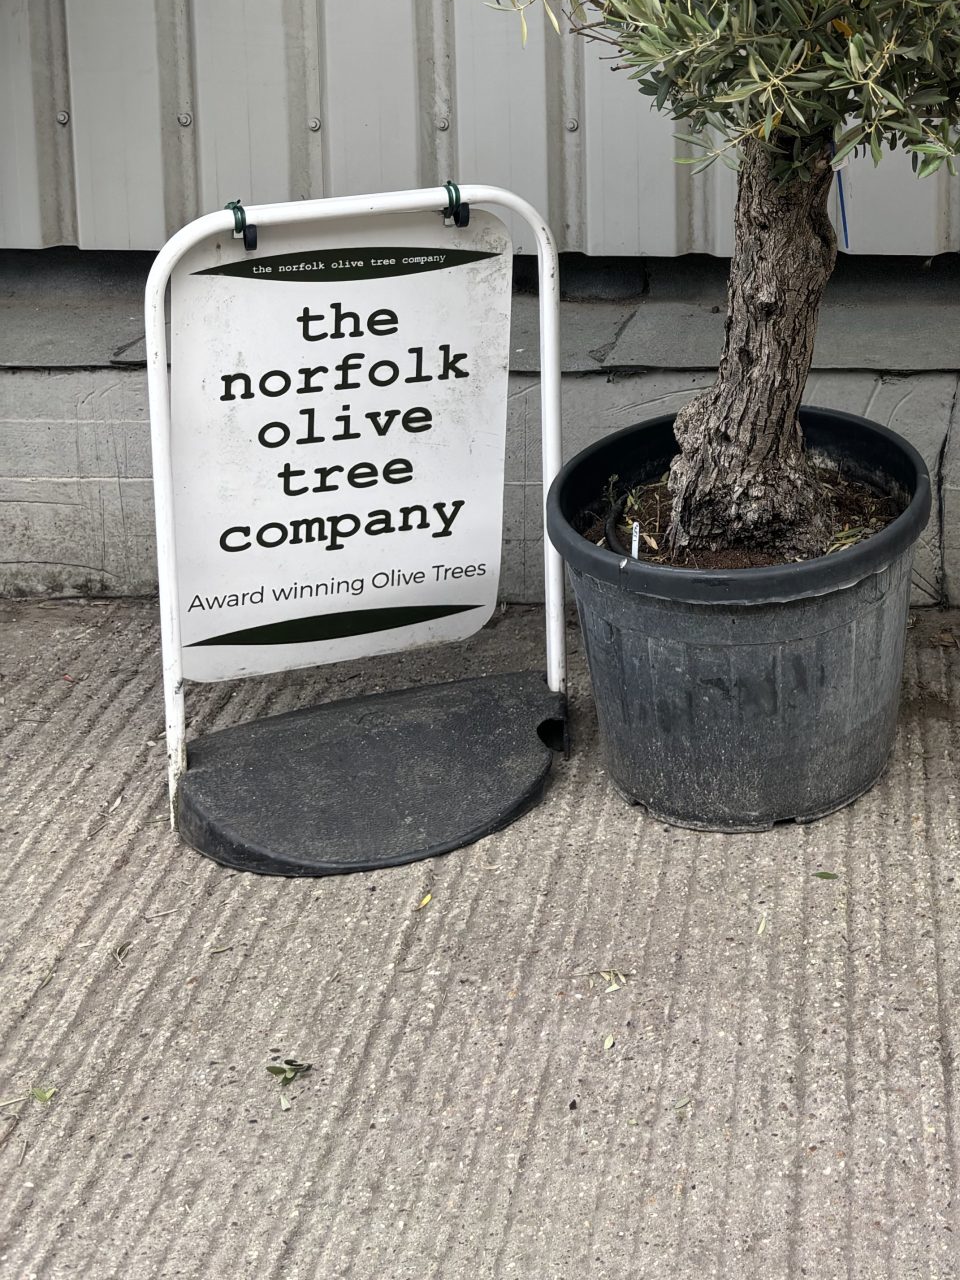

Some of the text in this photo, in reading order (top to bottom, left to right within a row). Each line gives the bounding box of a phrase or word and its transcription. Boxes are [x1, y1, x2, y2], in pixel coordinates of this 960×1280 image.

[252, 254, 446, 274] the norfolk olive tree company
[296, 302, 399, 342] the
[219, 344, 470, 402] norfolk
[257, 404, 433, 449] olive
[277, 457, 414, 497] tree
[219, 499, 466, 553] company
[187, 563, 487, 613] Award winning Olive Trees
